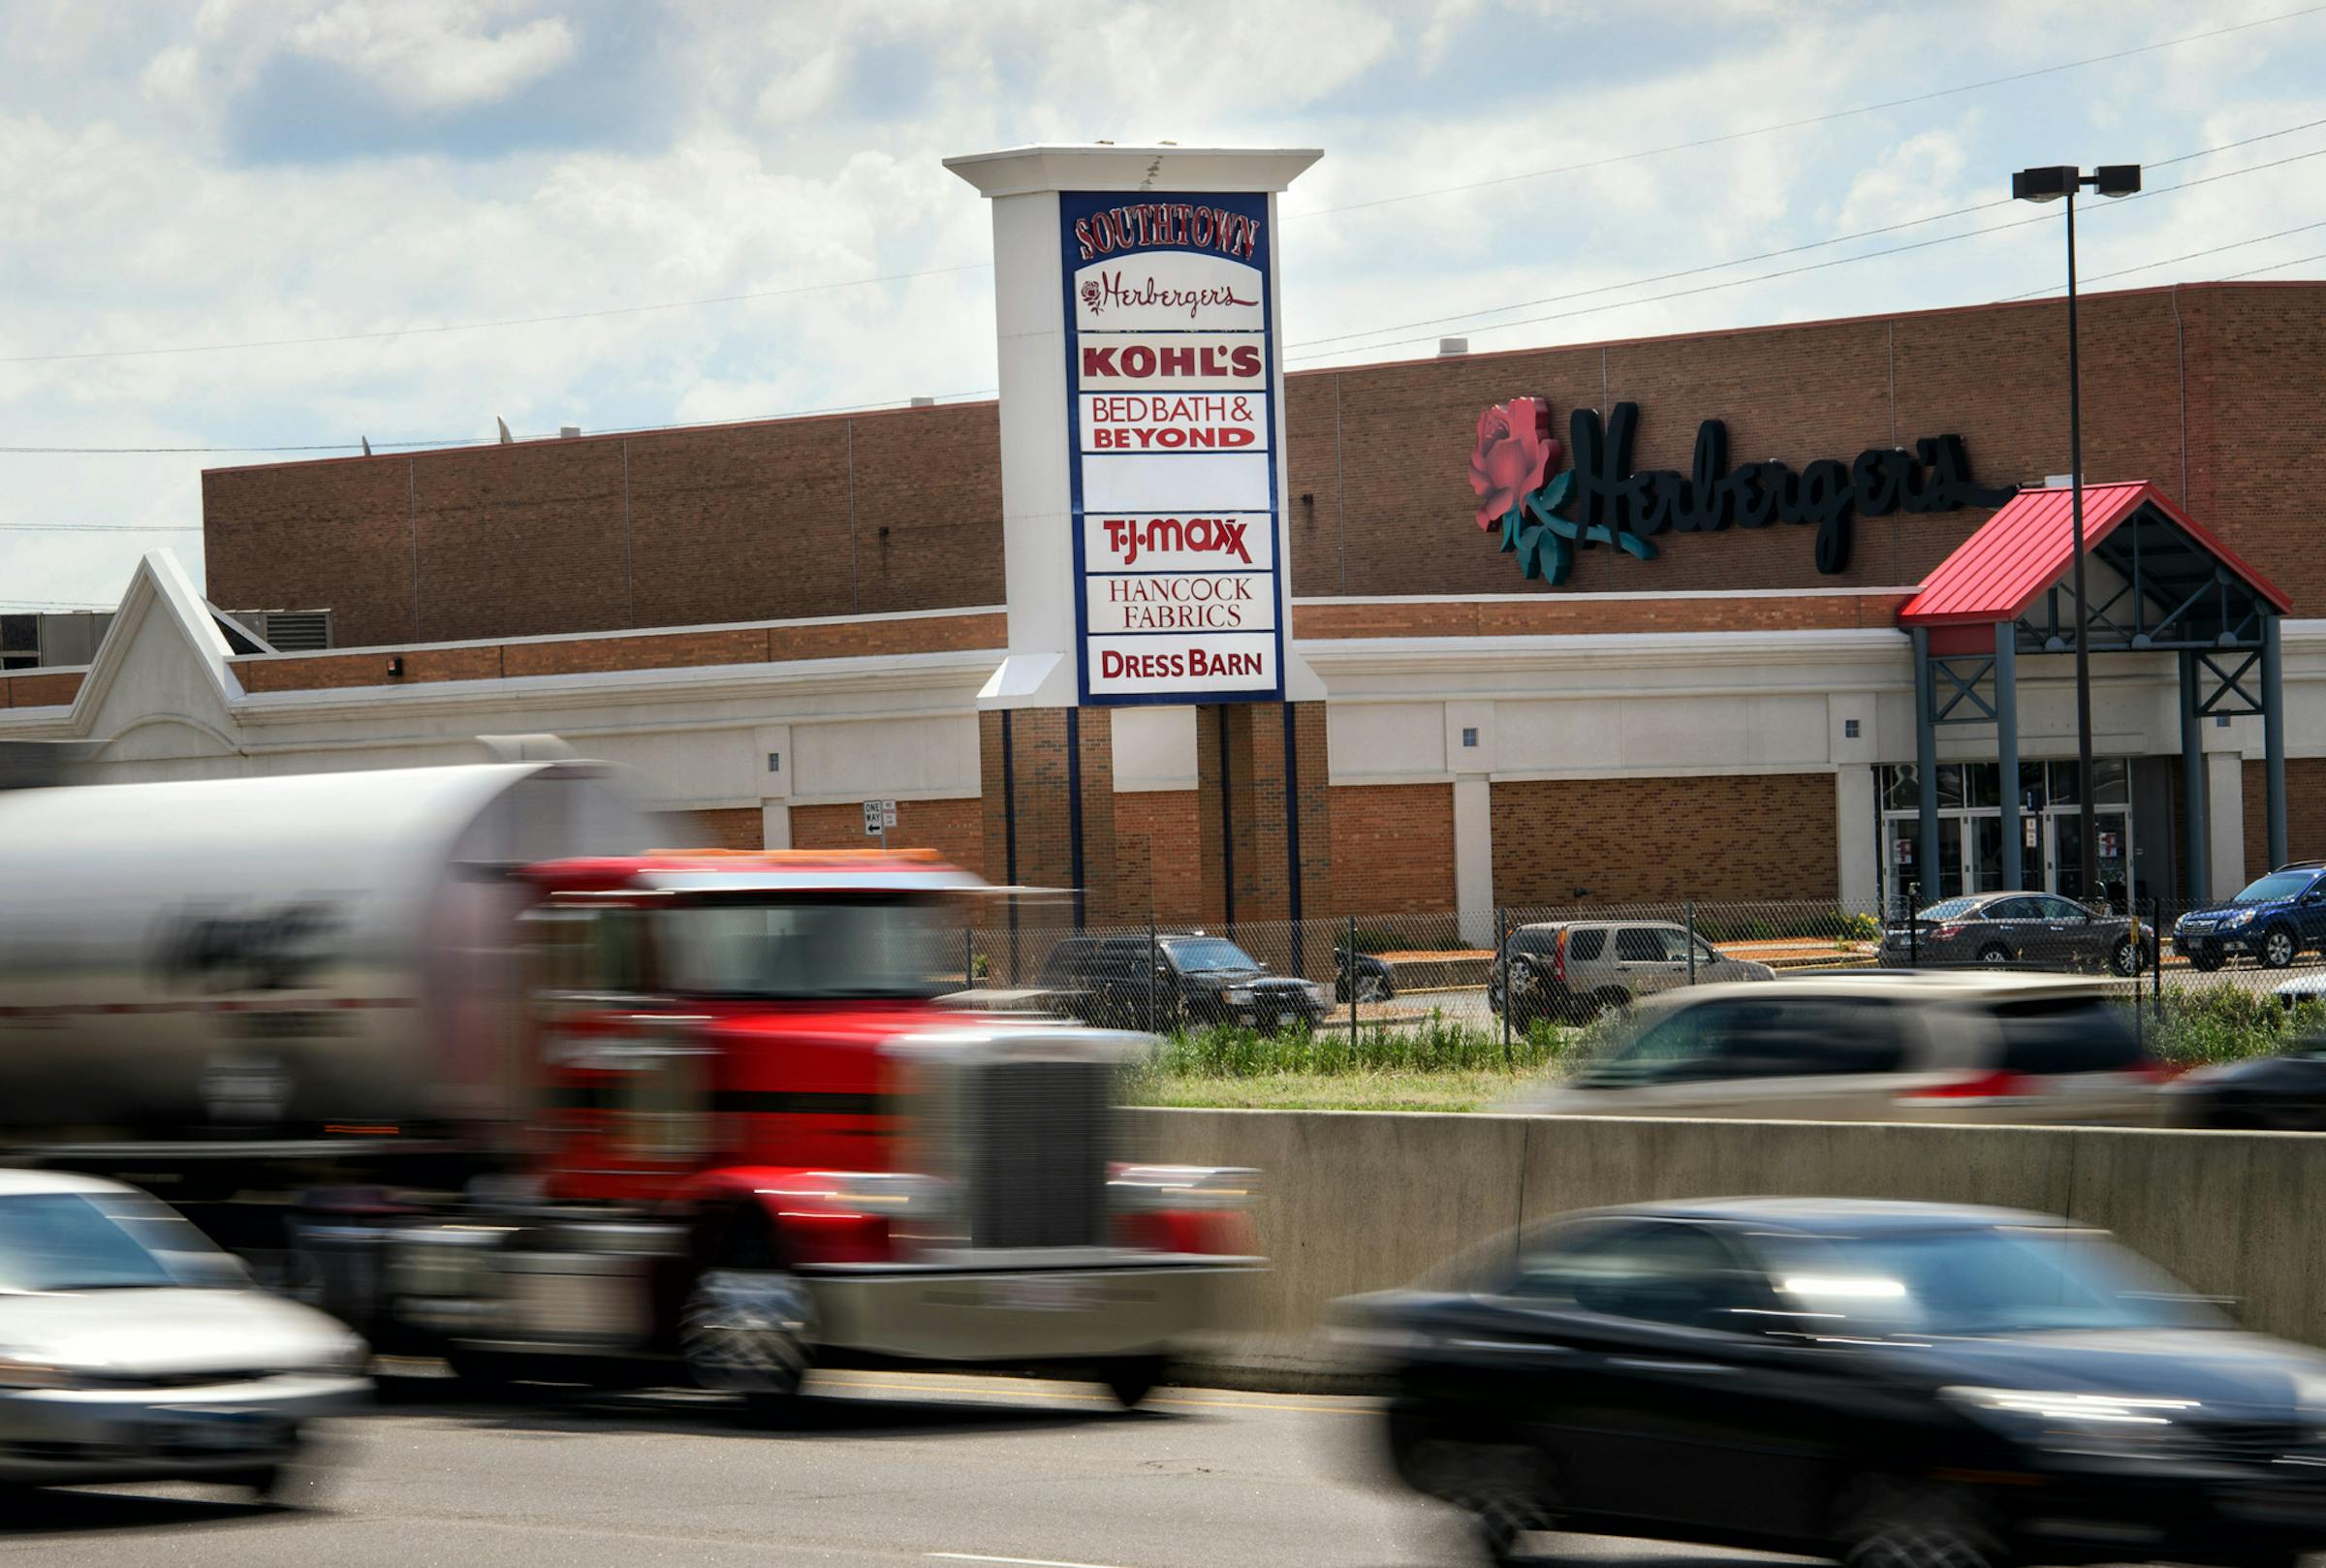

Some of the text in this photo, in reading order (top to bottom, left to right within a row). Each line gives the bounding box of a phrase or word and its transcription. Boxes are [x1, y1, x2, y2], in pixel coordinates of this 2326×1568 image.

[1075, 204, 1260, 260] SOUTHTOWN
[1101, 271, 1259, 318] Herberger's
[1083, 345, 1262, 378] KOHL'S
[1092, 395, 1254, 423] BED BATH &
[1094, 427, 1256, 448] BEYOND
[1569, 401, 2021, 575] Herberger's
[1109, 578, 1253, 602] HANCOCK
[1123, 604, 1242, 628] FABRICS
